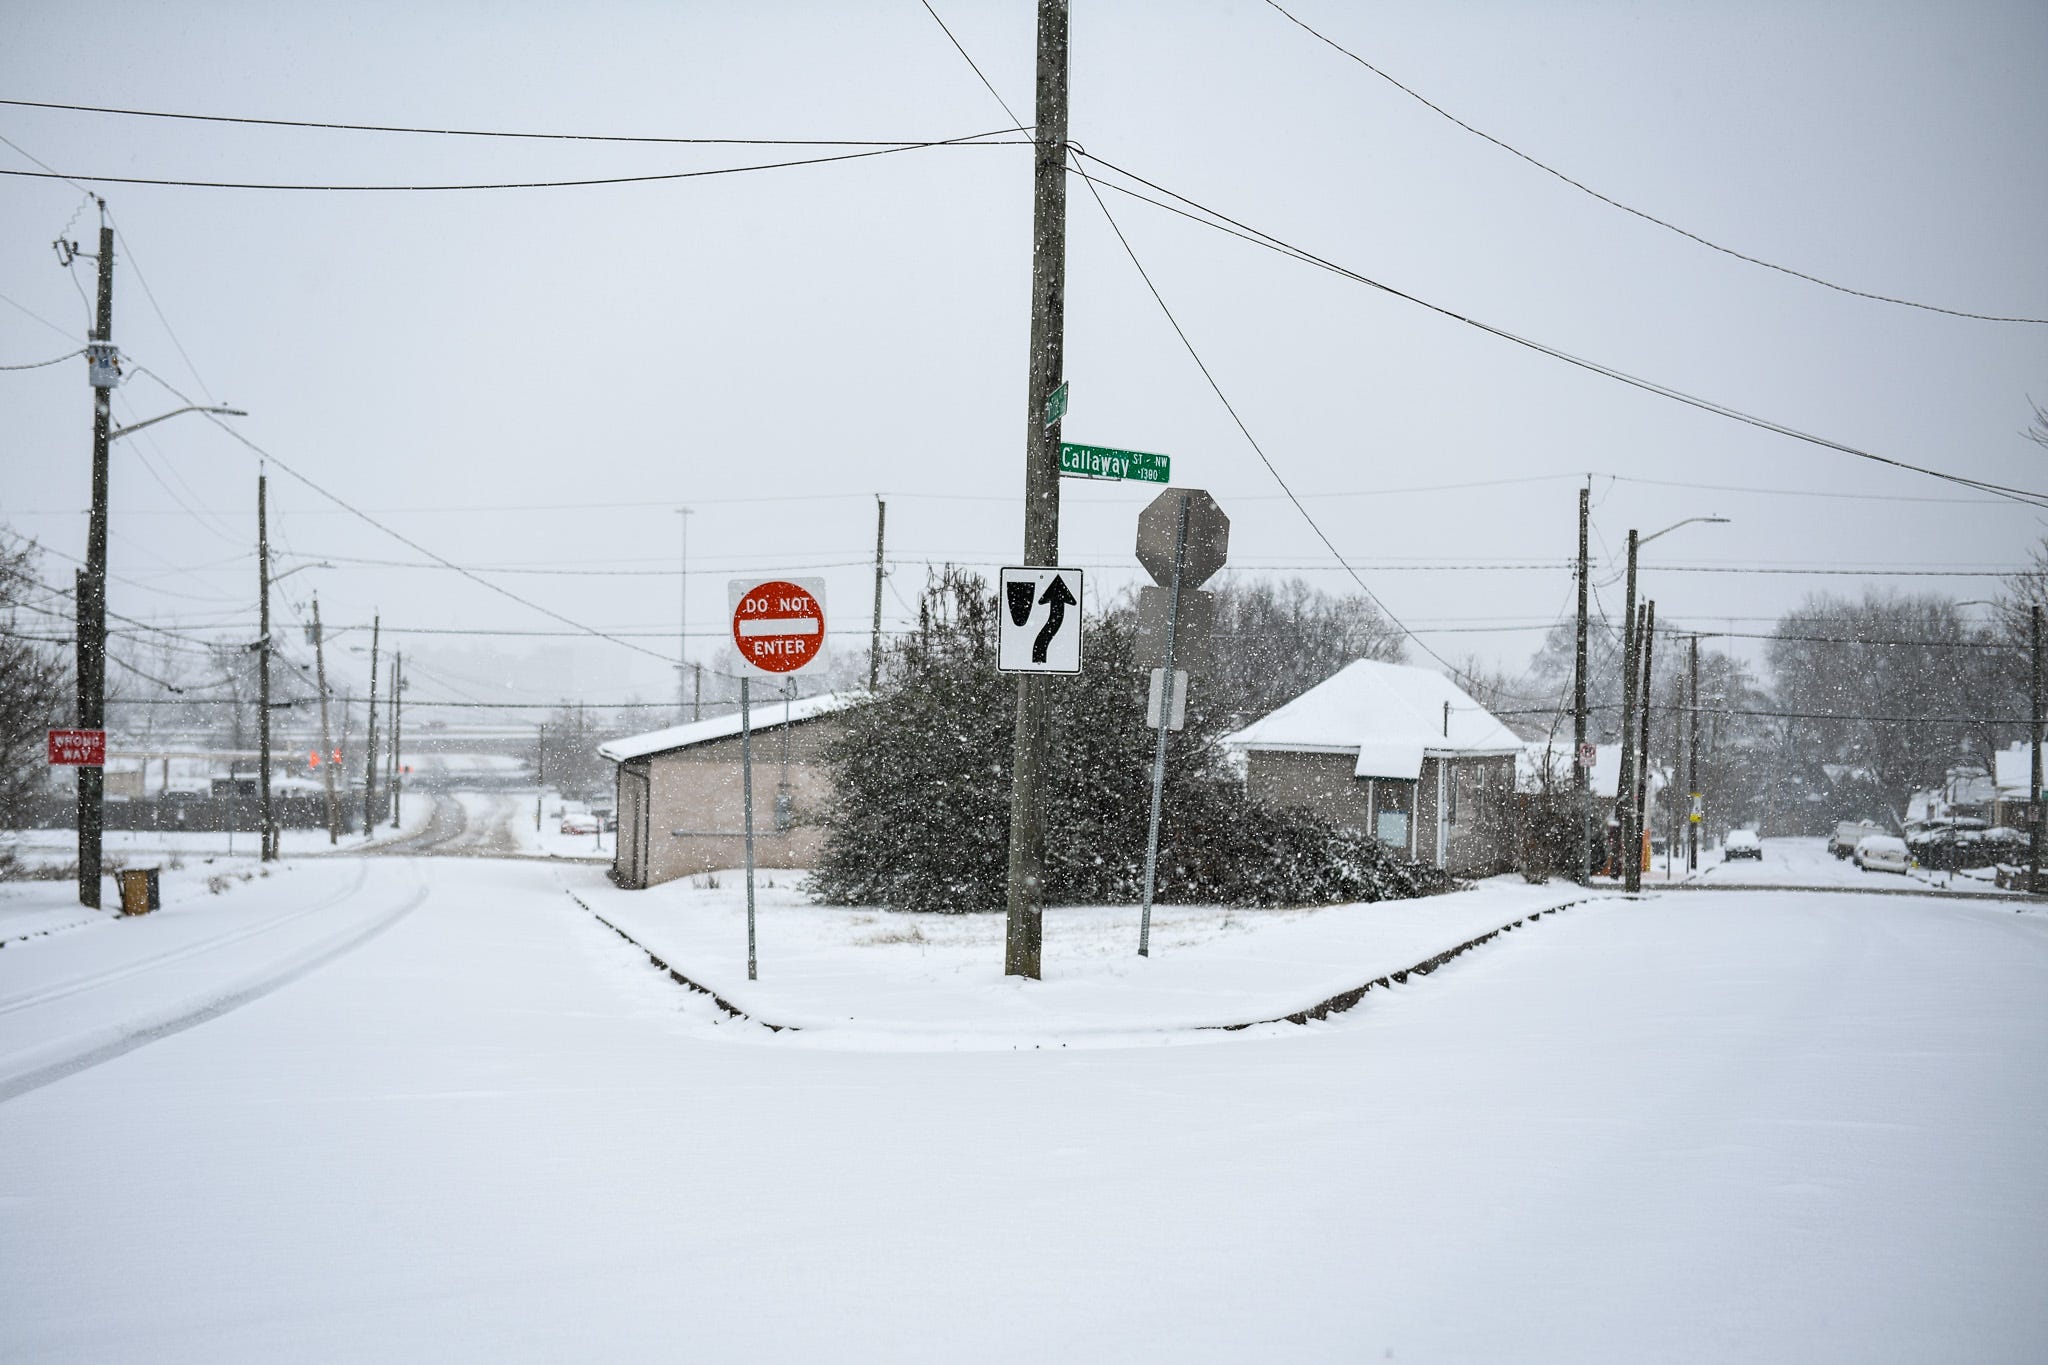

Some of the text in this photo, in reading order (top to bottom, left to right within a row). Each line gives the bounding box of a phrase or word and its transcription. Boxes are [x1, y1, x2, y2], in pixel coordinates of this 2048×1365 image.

[1062, 447, 1168, 477] Callaway ST NW
[746, 597, 809, 613] DO NOT
[754, 640, 805, 655] ENTER
[55, 735, 100, 747] WRONG
[63, 749, 91, 760] WAY
